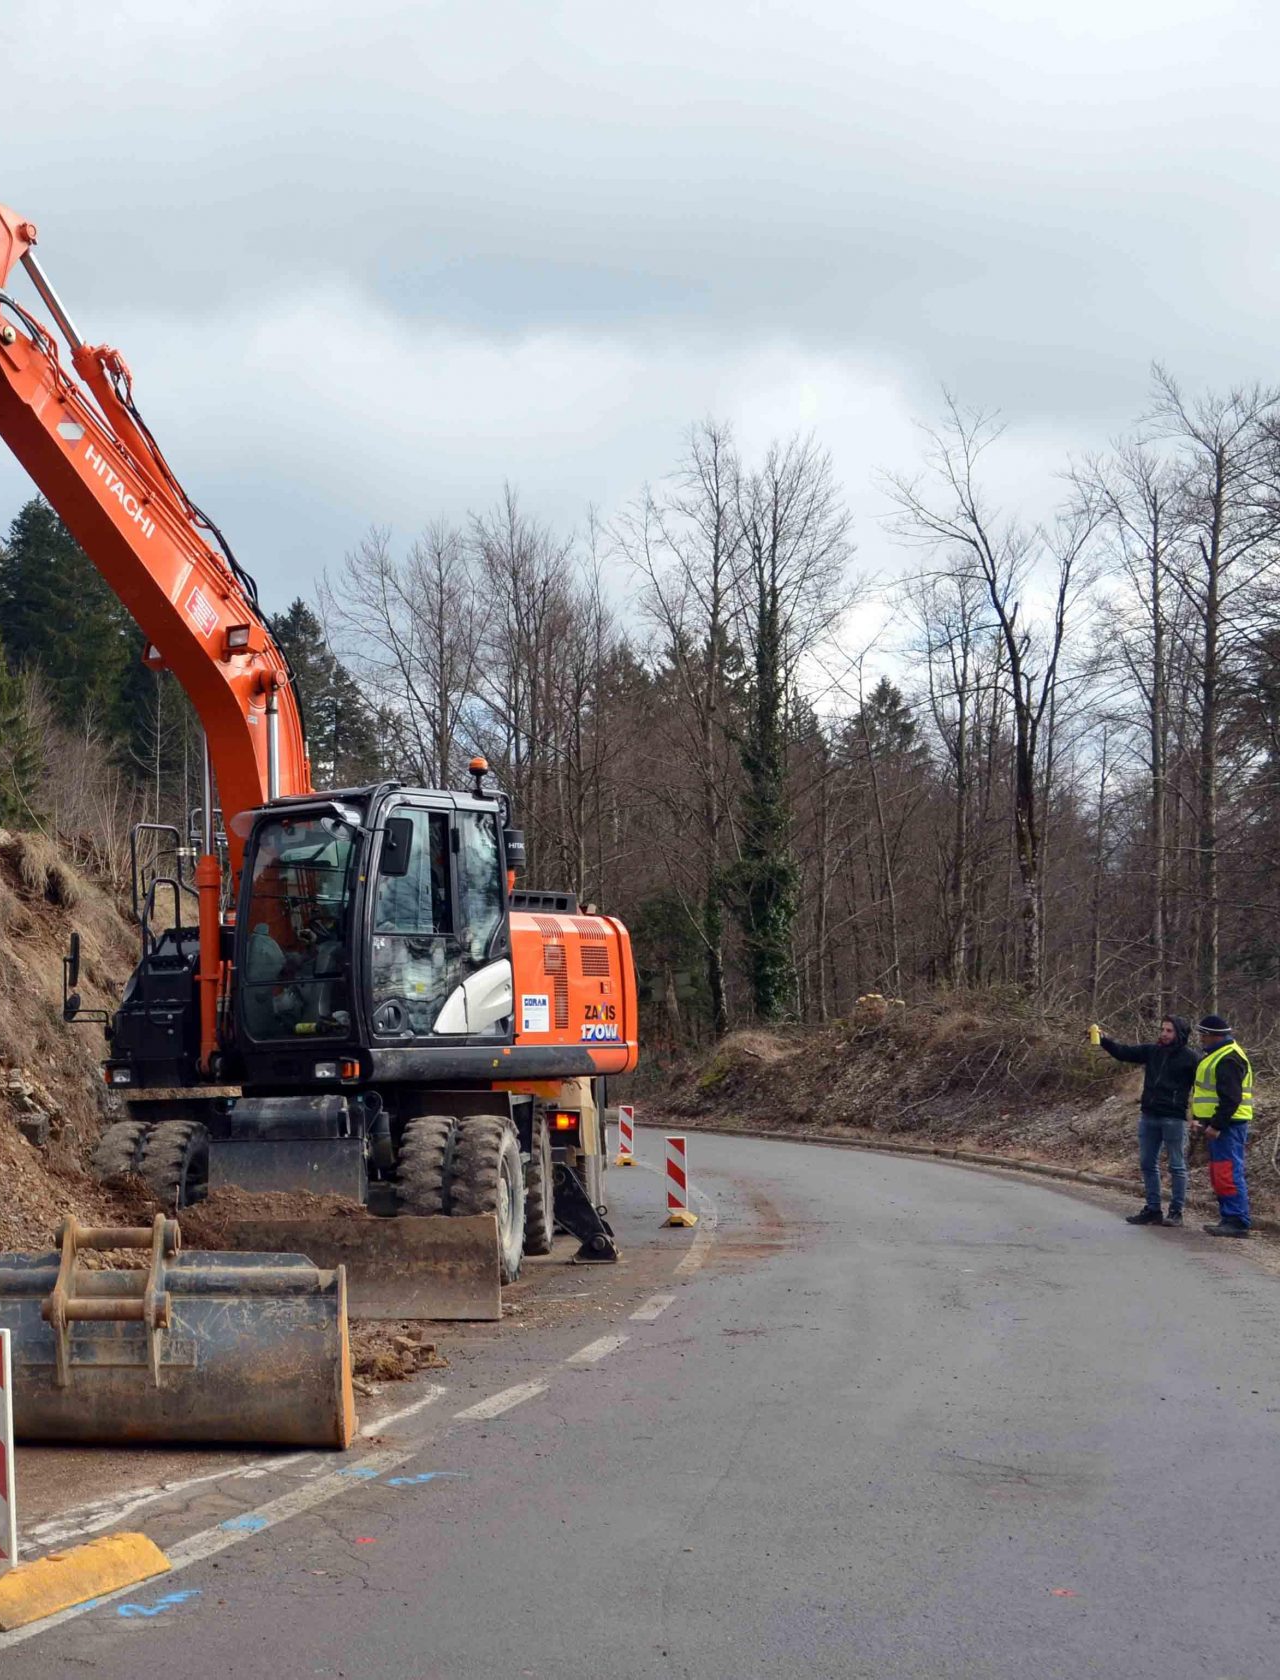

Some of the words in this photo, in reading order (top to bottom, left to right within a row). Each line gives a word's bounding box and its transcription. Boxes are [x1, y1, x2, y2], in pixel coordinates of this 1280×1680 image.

[85, 444, 155, 538] HITACHI
[585, 1002, 616, 1020] ZAXIS
[581, 1024, 618, 1040] 170W
